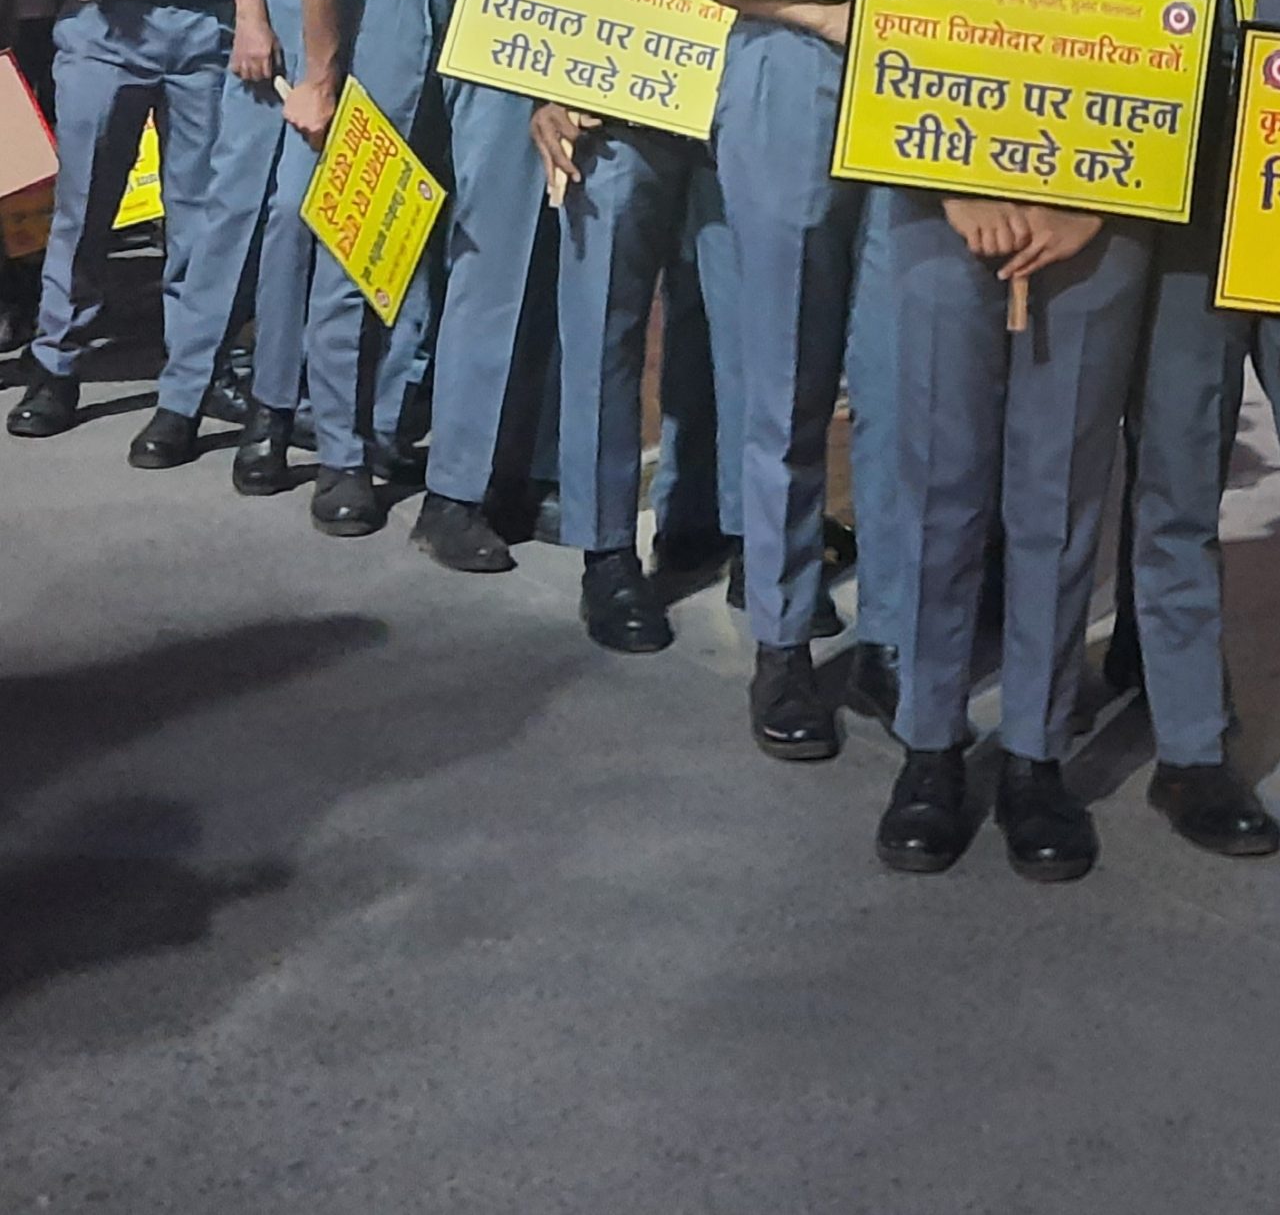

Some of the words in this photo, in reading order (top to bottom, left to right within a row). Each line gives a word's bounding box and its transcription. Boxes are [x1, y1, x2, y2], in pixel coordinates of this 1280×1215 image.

[491, 33, 555, 77] सीधे
[565, 56, 619, 99] खड़े
[629, 69, 680, 111] करें.
[597, 18, 635, 50] पर
[643, 30, 720, 71] वाहन
[874, 11, 939, 40] कृपया
[948, 15, 1044, 53] जिम्मेदार
[1051, 34, 1141, 66] नागरिक
[1148, 43, 1188, 73] बनें.
[874, 49, 1010, 111] सिग्नल
[1023, 82, 1071, 120] पर
[1085, 90, 1183, 135] वाहन
[343, 107, 372, 157] सीधा
[361, 125, 399, 194] सिग्नल
[894, 113, 977, 166] सीधे
[990, 130, 1060, 185] खड़े
[1074, 140, 1142, 189] करें.
[352, 189, 371, 218] पर
